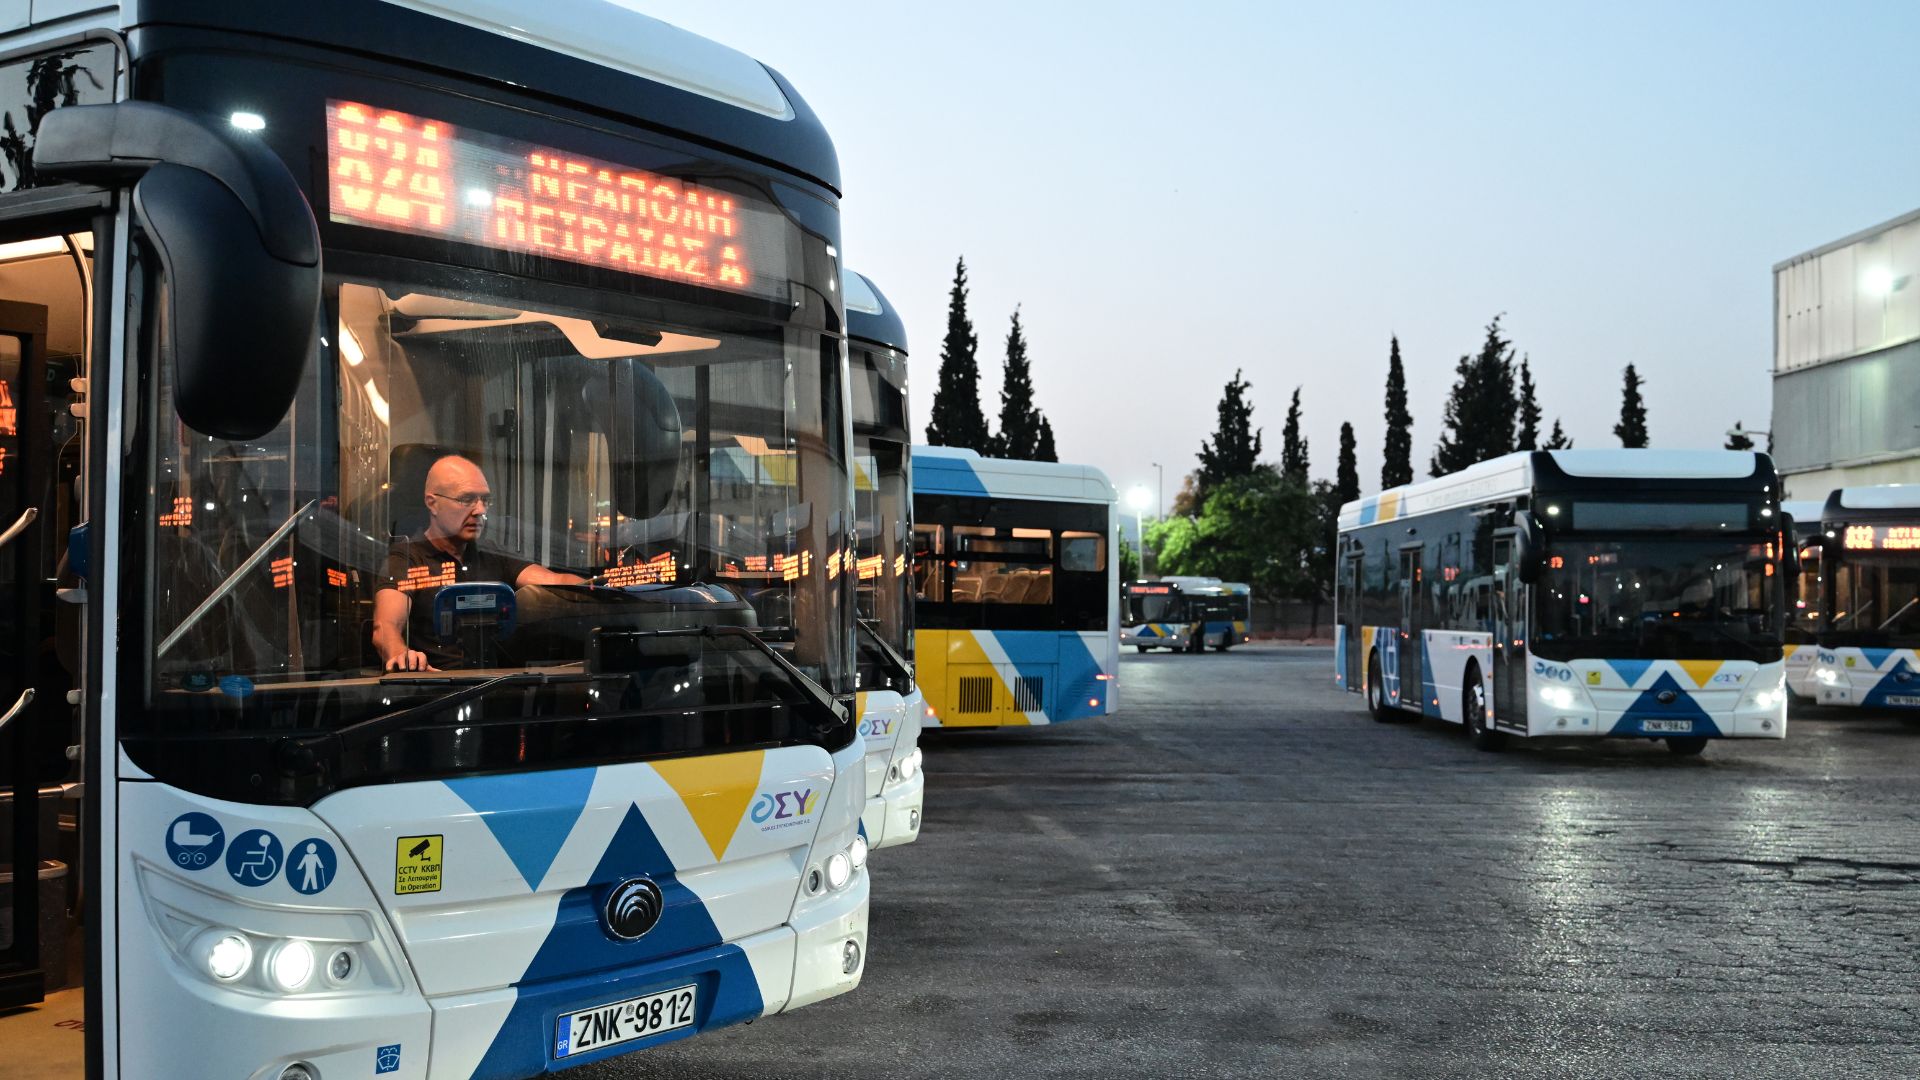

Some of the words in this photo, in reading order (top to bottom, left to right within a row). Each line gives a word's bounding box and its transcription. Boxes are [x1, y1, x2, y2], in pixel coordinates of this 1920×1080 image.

[336, 102, 447, 226] 824
[530, 153, 733, 238] ΝΕΑΠΟΛΗ
[495, 197, 706, 277] ΠΕΙΡΑΙΑΣ
[719, 245, 745, 285] Α
[751, 788, 811, 823] ΟΣΥ
[398, 866, 418, 874] CCTV
[557, 1039, 569, 1050] GR
